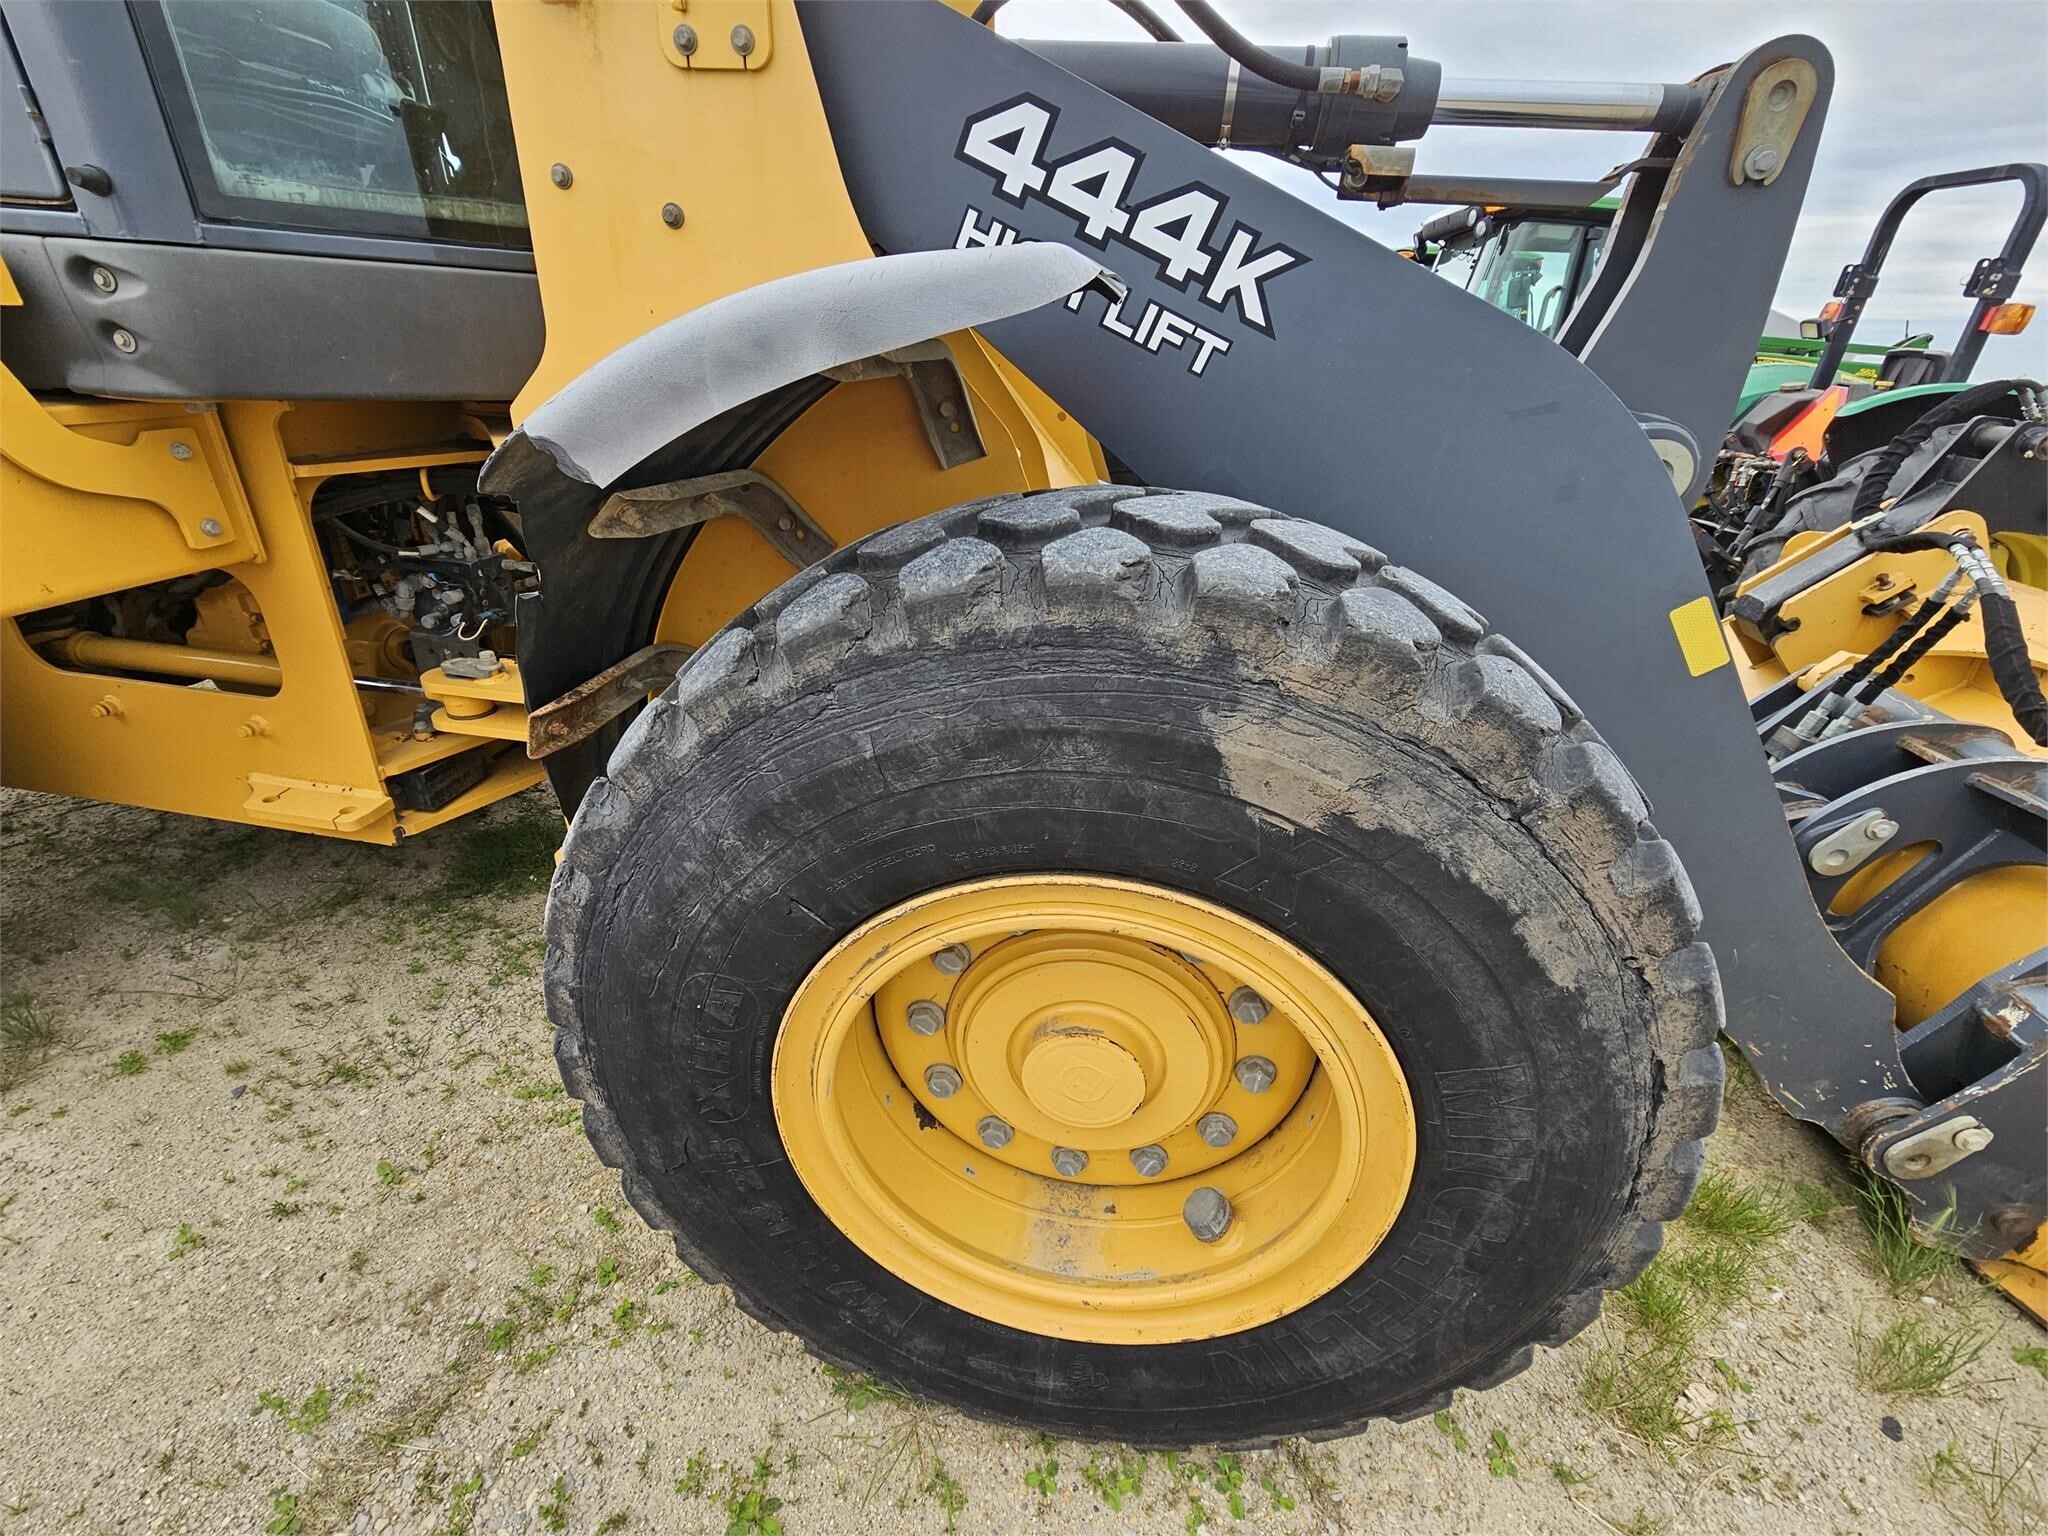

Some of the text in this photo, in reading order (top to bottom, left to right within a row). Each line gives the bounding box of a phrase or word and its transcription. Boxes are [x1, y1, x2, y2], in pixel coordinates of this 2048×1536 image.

[958, 96, 1304, 334] 444K
[1101, 289, 1233, 376] LIFT
[1207, 1063, 1538, 1386] MICHELIN
